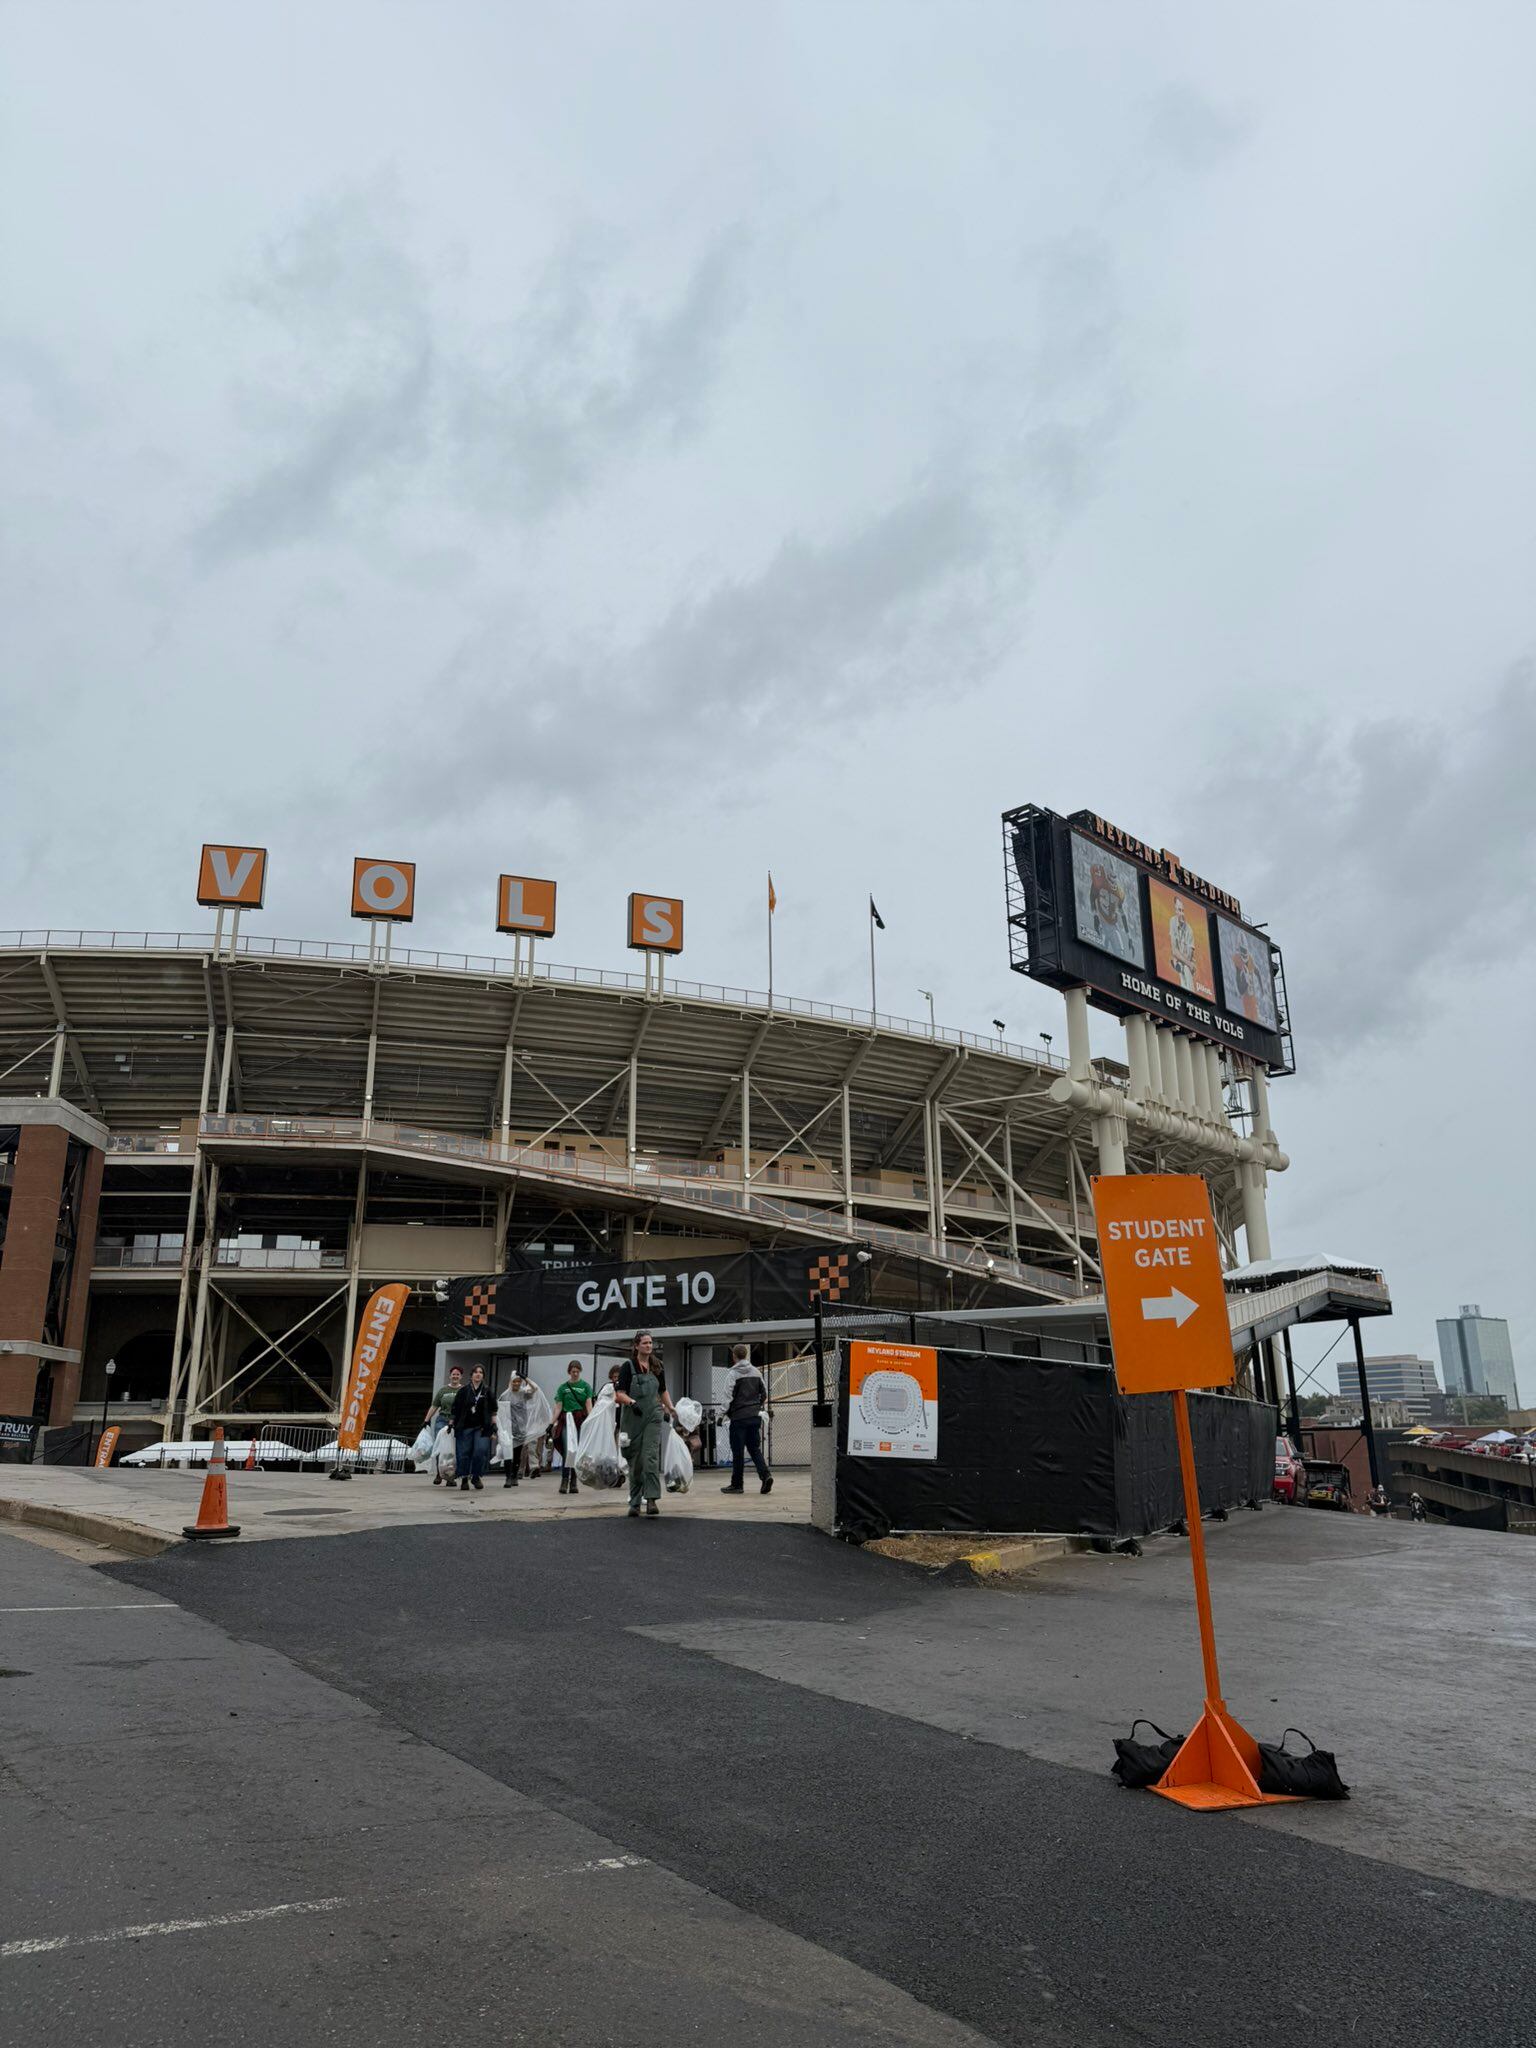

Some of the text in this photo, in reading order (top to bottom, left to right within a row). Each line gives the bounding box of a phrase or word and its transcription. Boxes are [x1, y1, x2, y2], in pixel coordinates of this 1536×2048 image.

[1095, 815, 1163, 869] NEYLAND
[1183, 869, 1241, 916] STADIUM
[1121, 972, 1161, 1002] HOME
[1165, 993, 1182, 1011] OF
[1186, 1001, 1211, 1025] THE
[1214, 1015, 1244, 1040] VOLS
[1108, 1219, 1205, 1240] STUDENT
[1134, 1247, 1191, 1268] GATE
[576, 1271, 716, 1313] GATE 10
[344, 1296, 396, 1434] ENTRANCE
[0, 1422, 34, 1434] TRULY
